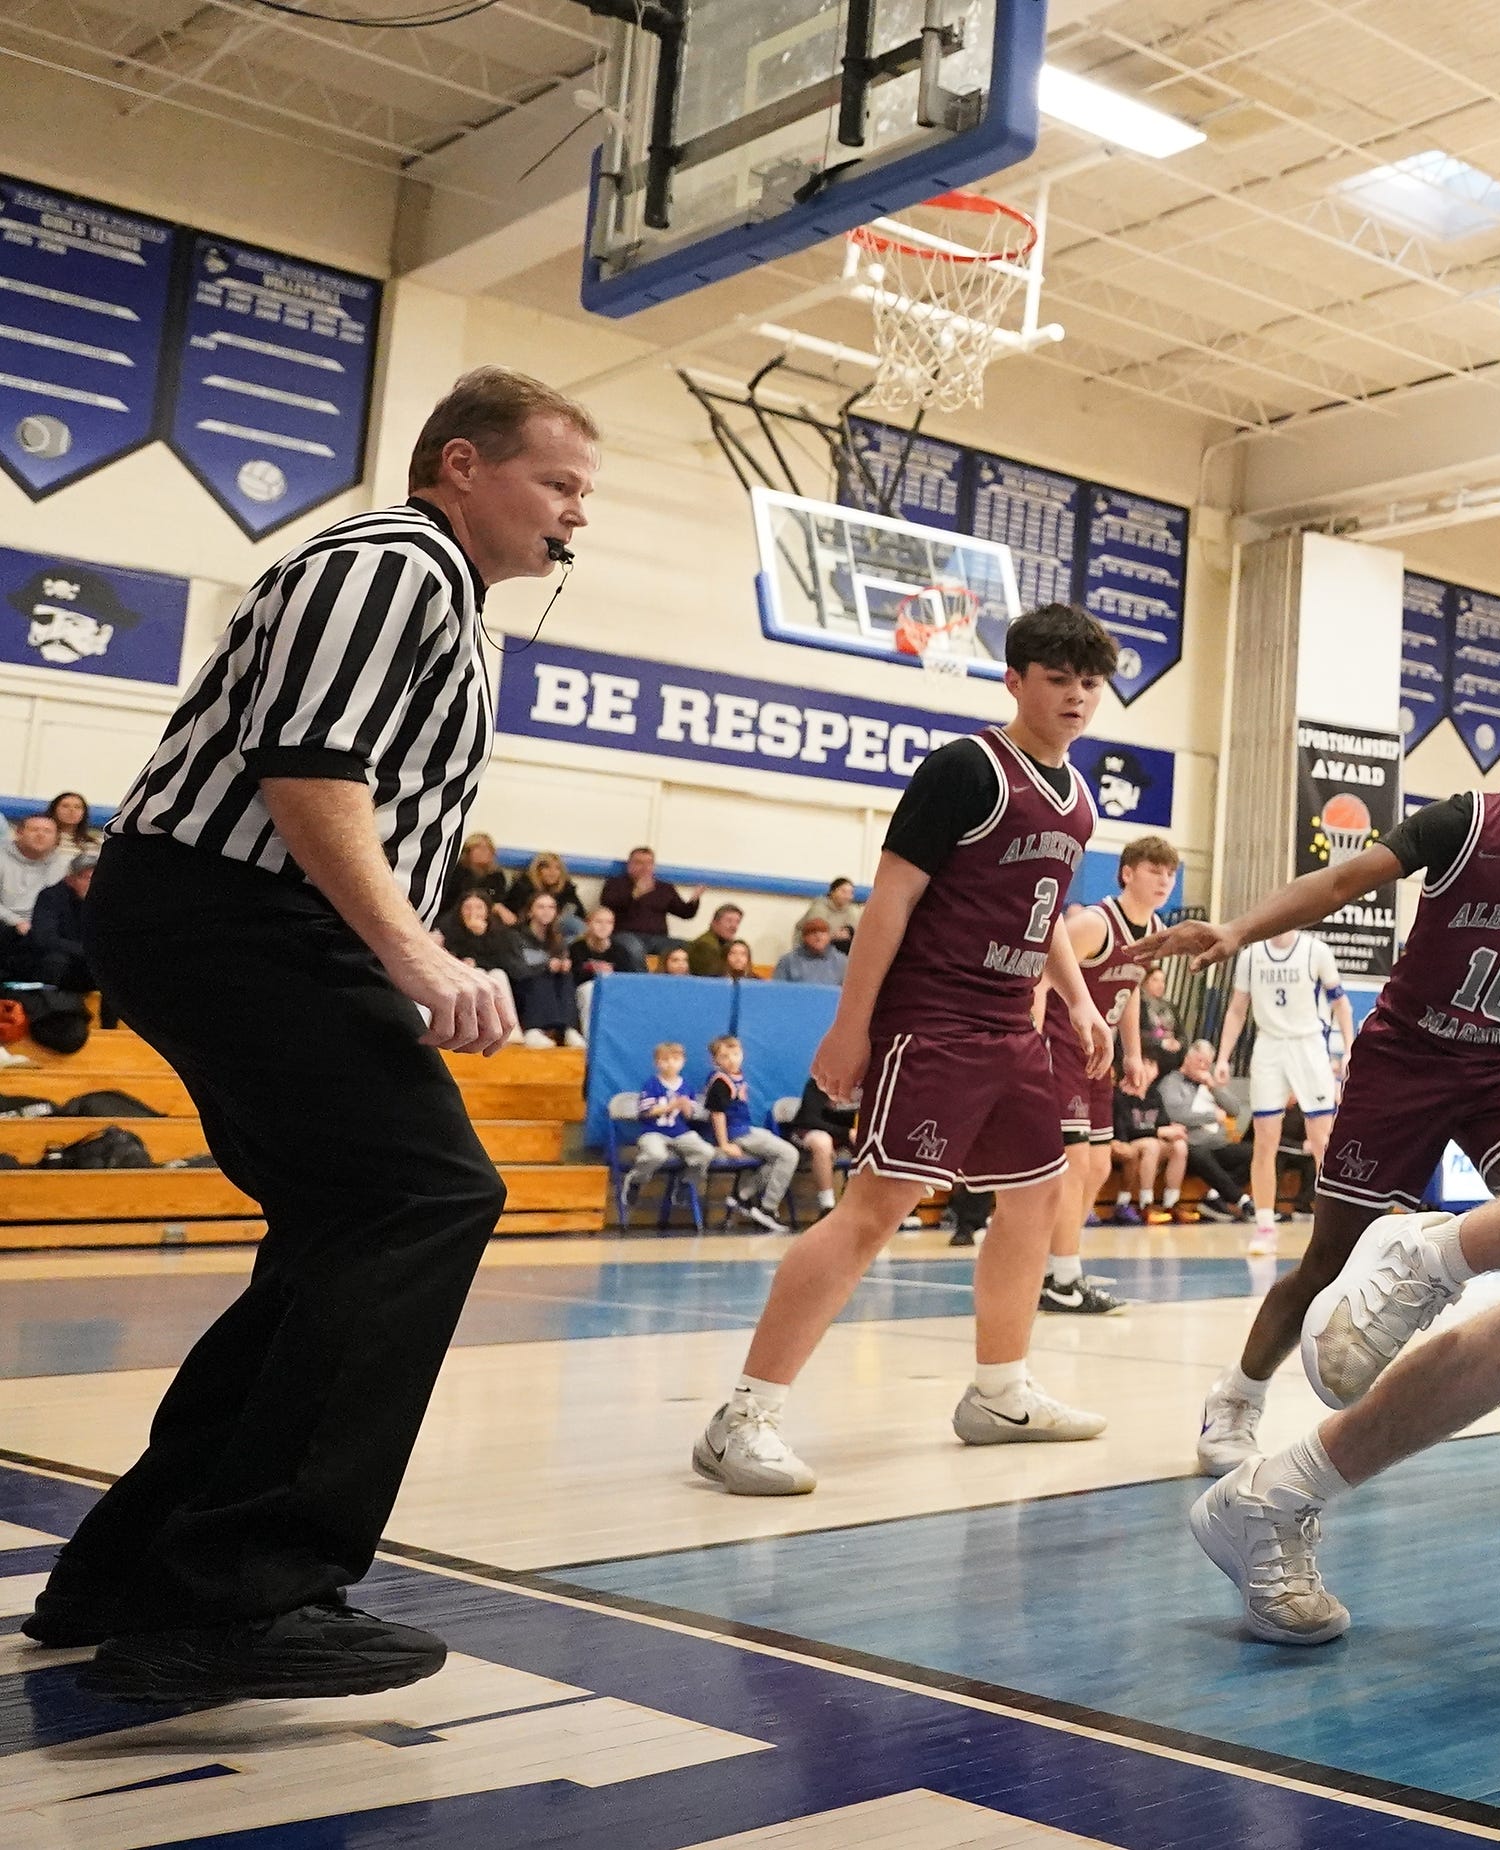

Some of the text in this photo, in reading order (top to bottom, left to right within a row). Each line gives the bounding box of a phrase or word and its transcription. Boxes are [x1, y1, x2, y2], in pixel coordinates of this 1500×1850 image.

[529, 662, 640, 735] BE
[1298, 727, 1399, 760] SPORTSMANSHIP
[1311, 758, 1386, 787] AWARD
[1024, 877, 1059, 943] 2
[1260, 968, 1300, 984] PIRATES
[1275, 988, 1287, 1007] 3
[907, 1119, 949, 1162] AM
[1336, 1139, 1378, 1182] AM
